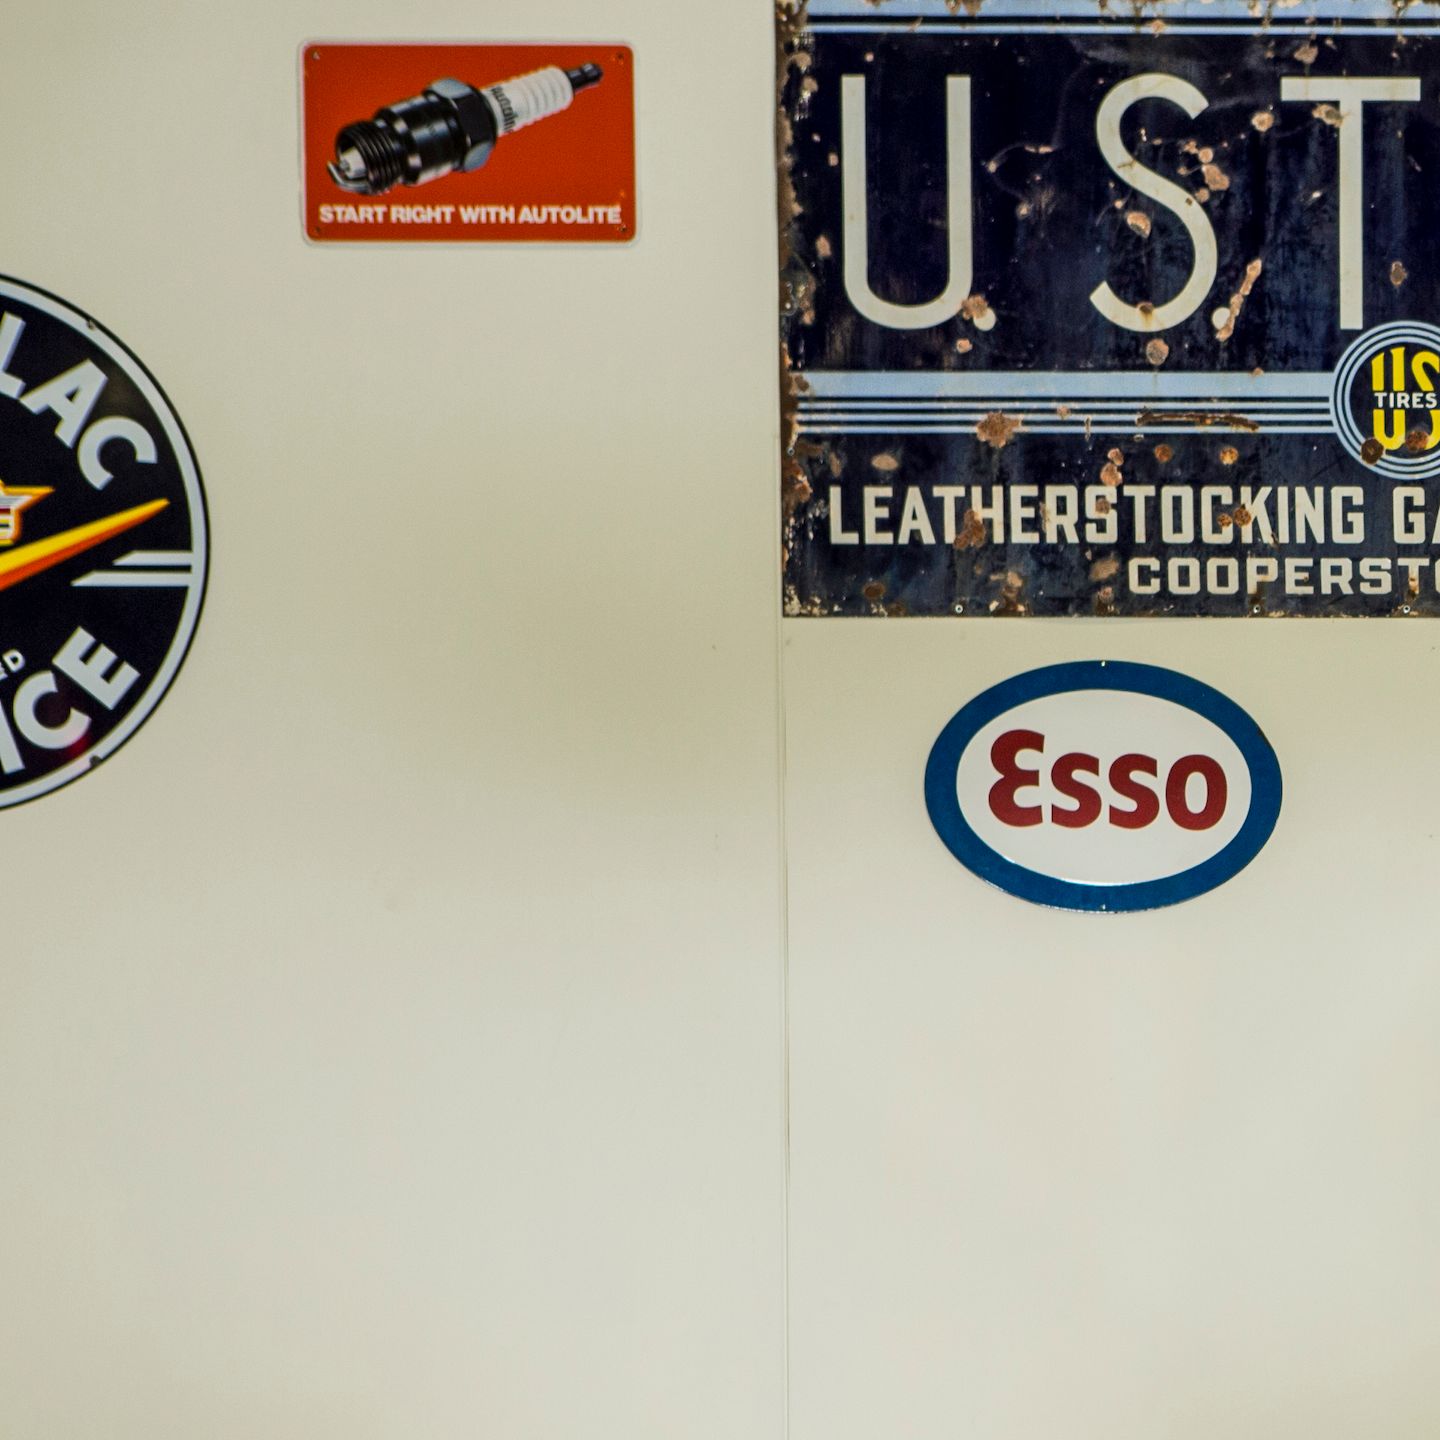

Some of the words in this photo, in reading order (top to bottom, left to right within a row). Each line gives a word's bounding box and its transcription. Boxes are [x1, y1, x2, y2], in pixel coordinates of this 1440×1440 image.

[319, 204, 387, 223] START
[390, 204, 455, 223] RIGHT
[460, 204, 519, 224] WITH
[519, 204, 622, 224] AUTOLITE
[1374, 392, 1438, 409] TIRES
[829, 485, 1366, 546] LEATHERSTOCKING
